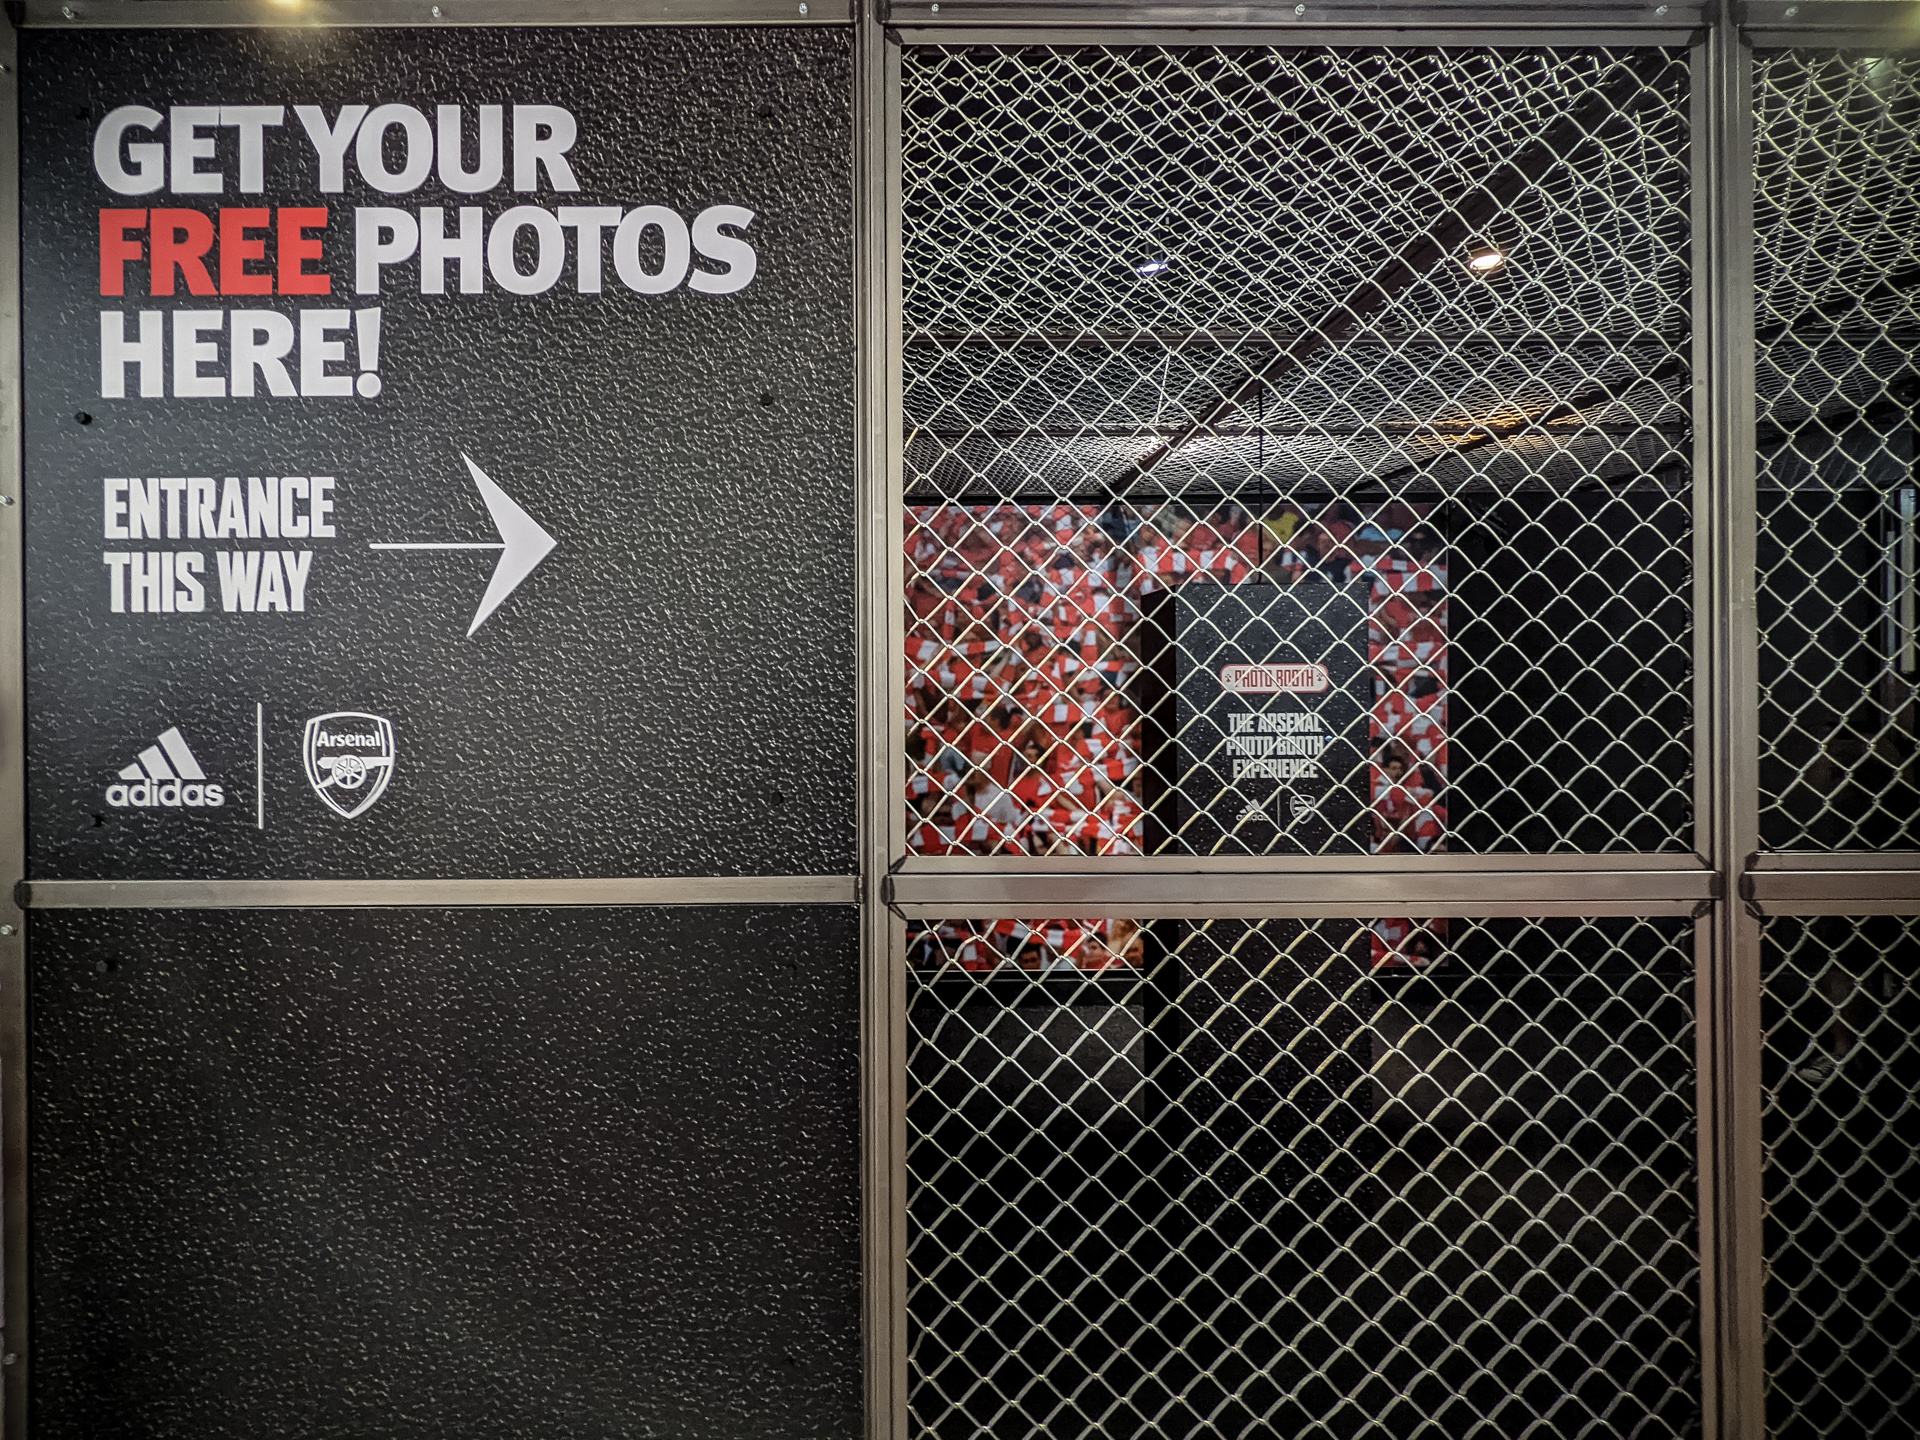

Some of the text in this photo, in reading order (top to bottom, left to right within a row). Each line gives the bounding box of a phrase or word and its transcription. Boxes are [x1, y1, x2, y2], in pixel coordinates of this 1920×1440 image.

[94, 104, 580, 196] GET YOUR
[99, 205, 757, 296] FREE PHOTOS
[100, 306, 382, 399] HERE!
[103, 476, 336, 540] ENTRANCE
[103, 550, 313, 613] THIS WAY
[1234, 669, 1315, 688] PHOTO BOOTH
[1227, 712, 1322, 733] THE ARSENAL
[316, 731, 383, 748] Arsenal
[1226, 735, 1325, 756] PHOTO BOOTH
[1232, 758, 1318, 778] EXPERIENCE
[105, 778, 226, 807] adidas
